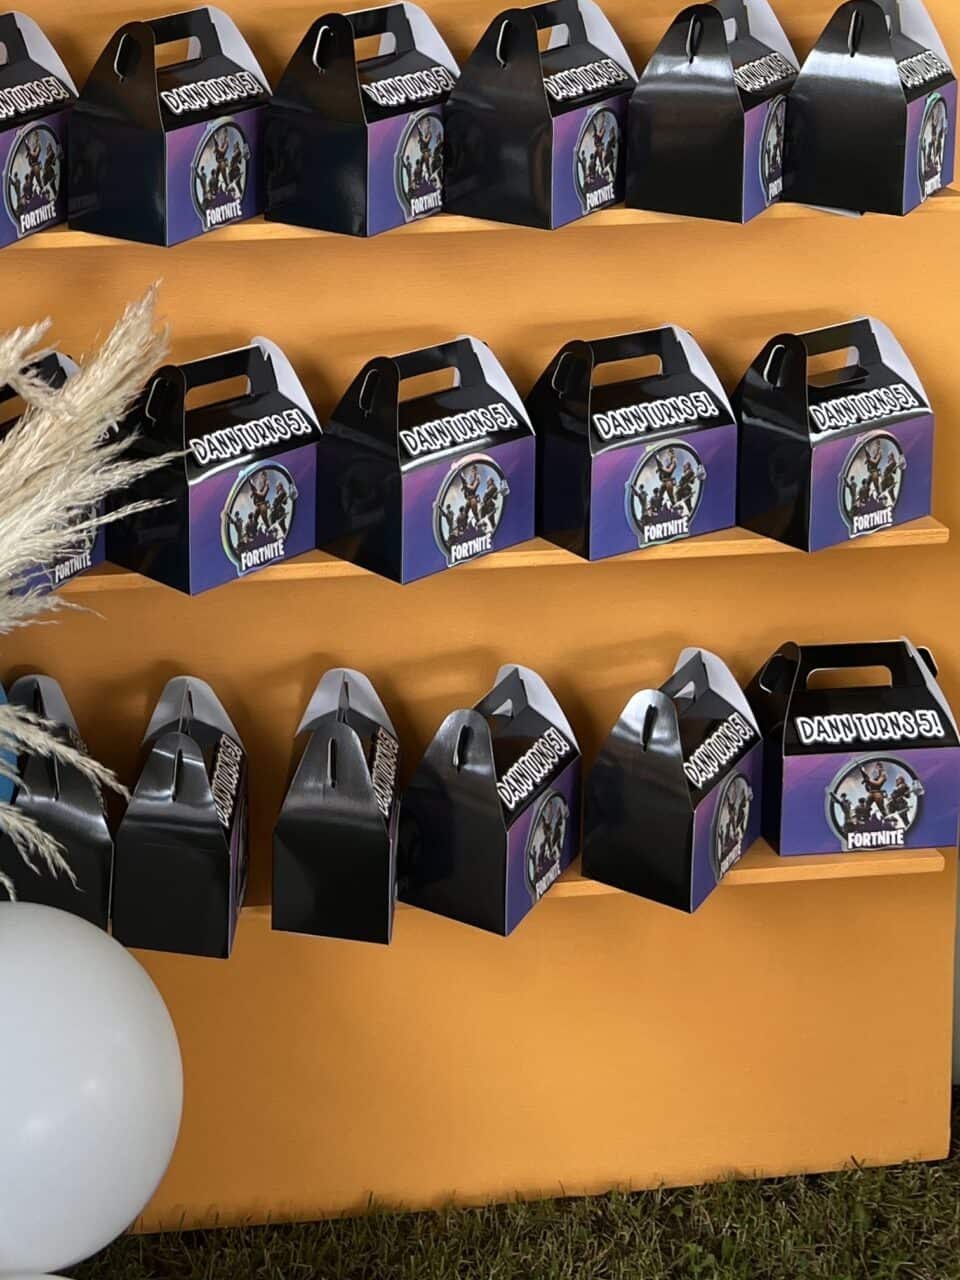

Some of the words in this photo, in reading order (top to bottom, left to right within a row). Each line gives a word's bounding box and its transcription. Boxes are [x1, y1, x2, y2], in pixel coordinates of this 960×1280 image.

[20, 200, 58, 233] FORTNITE
[205, 197, 243, 229] FORTNITE
[593, 405, 646, 439] DANN
[638, 395, 697, 428] TURNS
[689, 391, 719, 416] 5!
[809, 397, 857, 430] DANN
[847, 388, 900, 420] TURNS
[890, 383, 919, 407] 5!
[189, 428, 241, 464] DANN
[233, 414, 291, 450] TURNS
[283, 408, 311, 435] 5!
[399, 419, 450, 456] DANN
[441, 407, 498, 442] TURNS
[488, 402, 518, 429] 5!
[644, 516, 689, 544] FORTNITE
[852, 506, 894, 534] FORTNITE
[240, 539, 285, 572] FORTNITE
[450, 533, 492, 564] FORTNITE
[55, 552, 92, 583] FORTNITE
[797, 714, 856, 744] DANN
[852, 711, 918, 741] TURNS
[916, 709, 944, 738] 5!
[847, 829, 904, 849] FORTNITE
